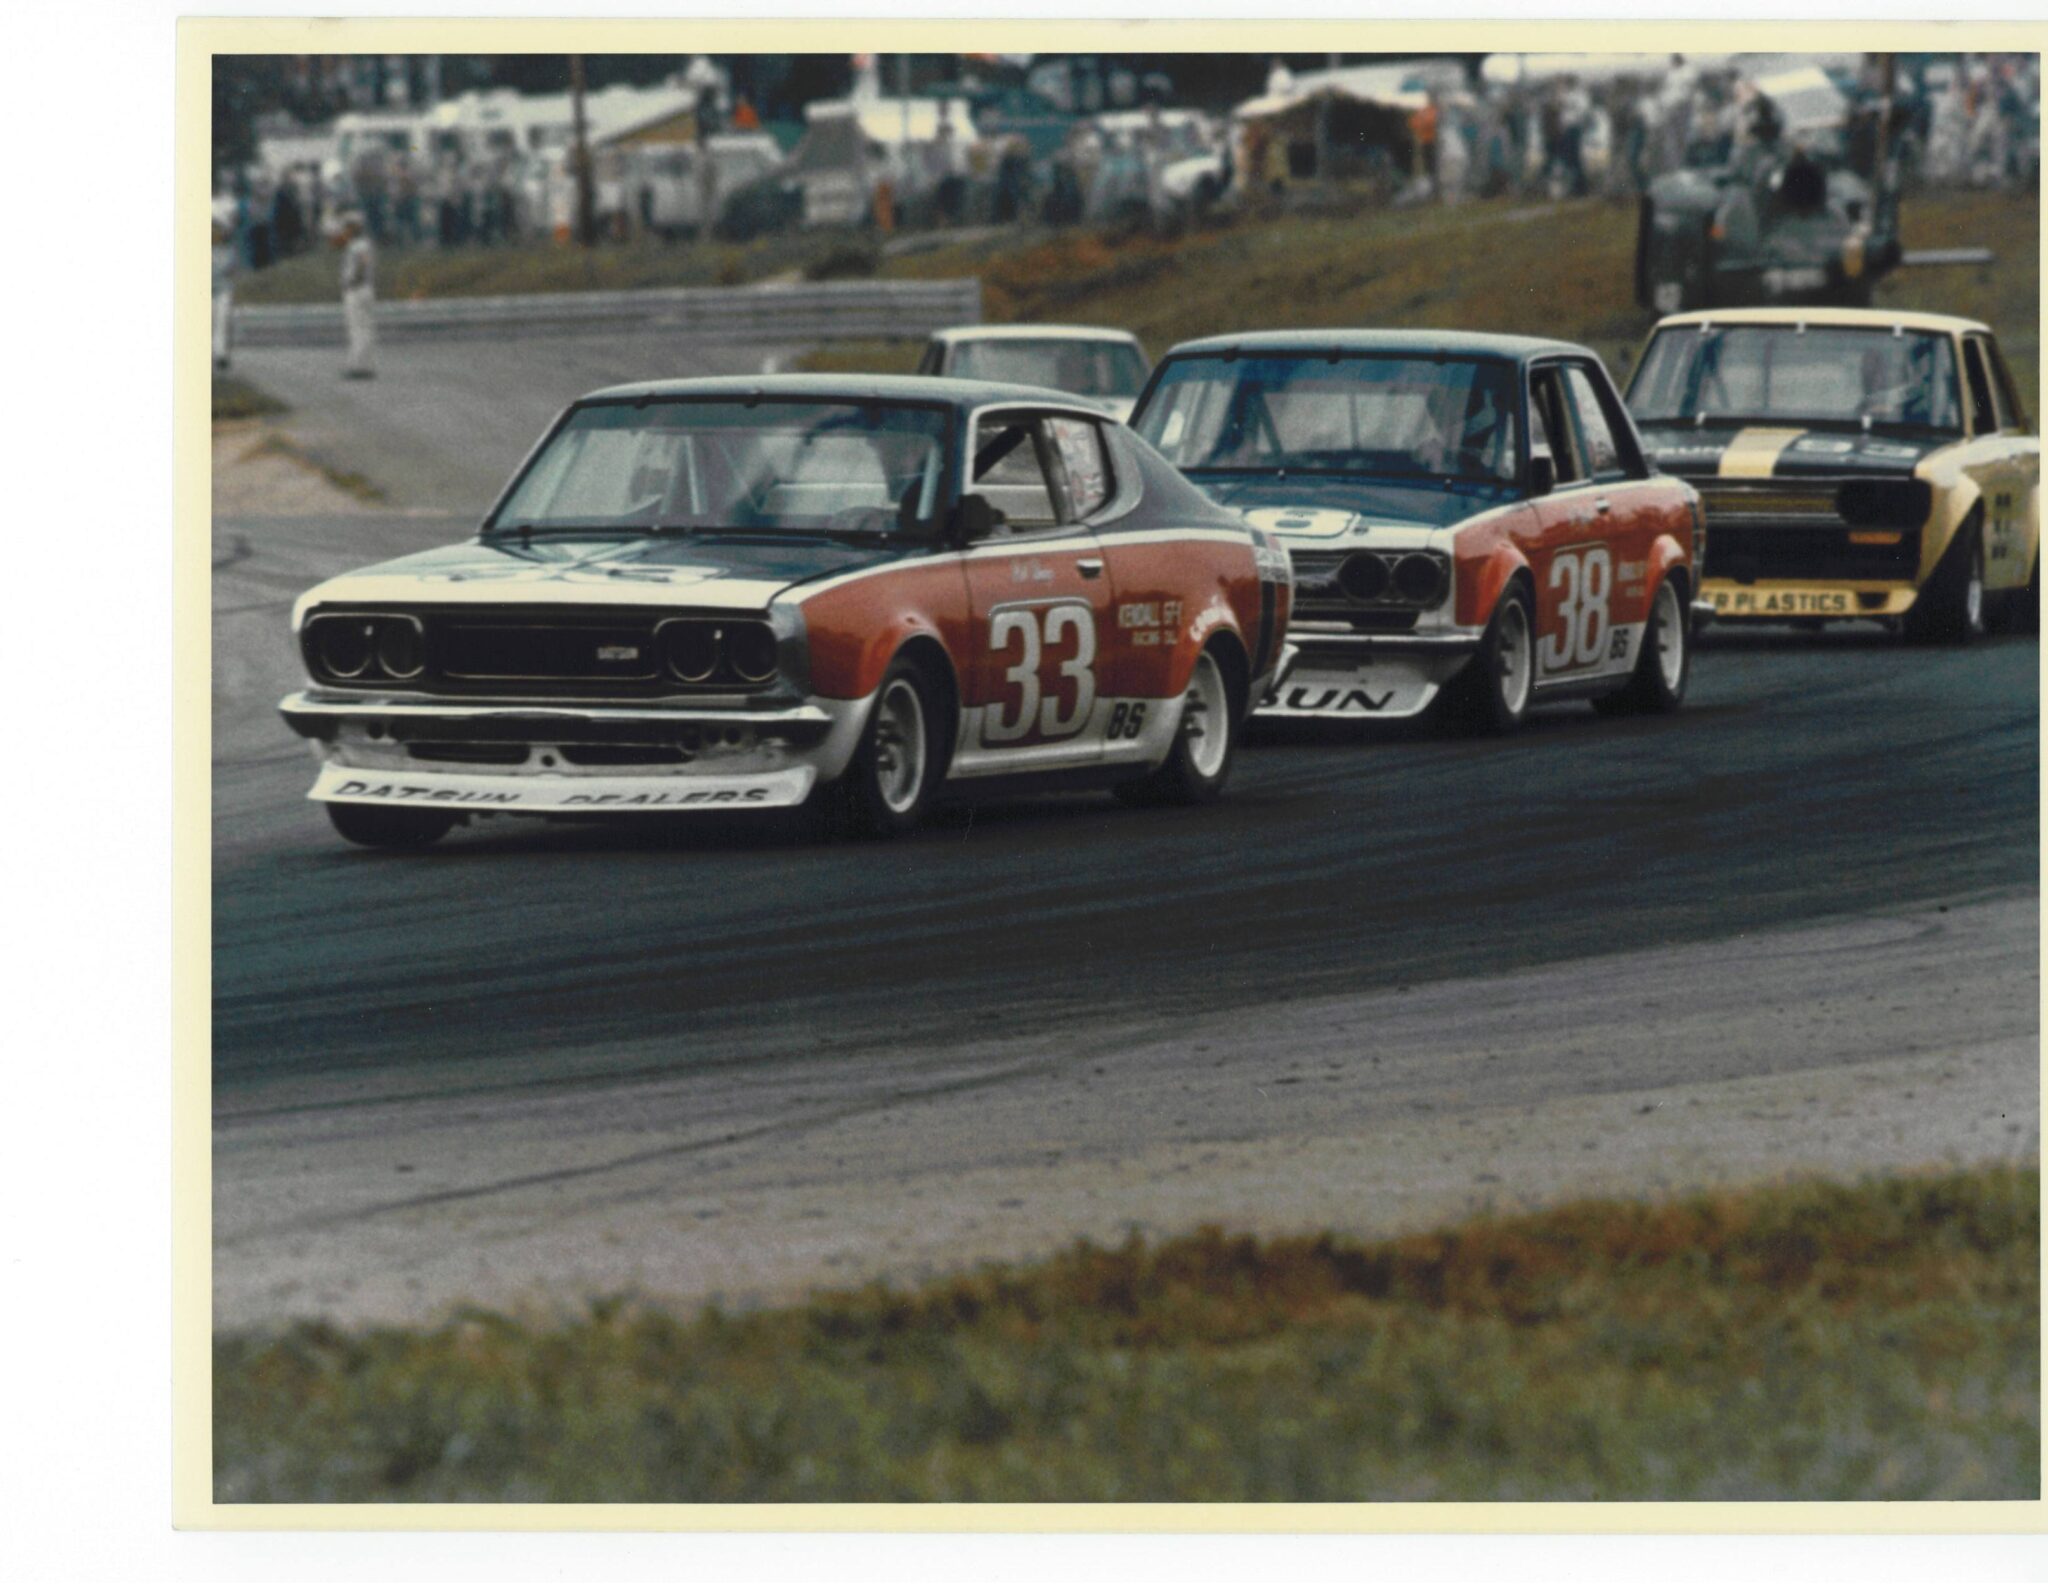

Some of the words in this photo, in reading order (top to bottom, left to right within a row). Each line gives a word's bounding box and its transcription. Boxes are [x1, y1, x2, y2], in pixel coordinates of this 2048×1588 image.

[1544, 549, 1611, 669] 38
[1735, 592, 1847, 611] PLASTICS
[984, 605, 1096, 742] 33
[1106, 702, 1147, 740] BS
